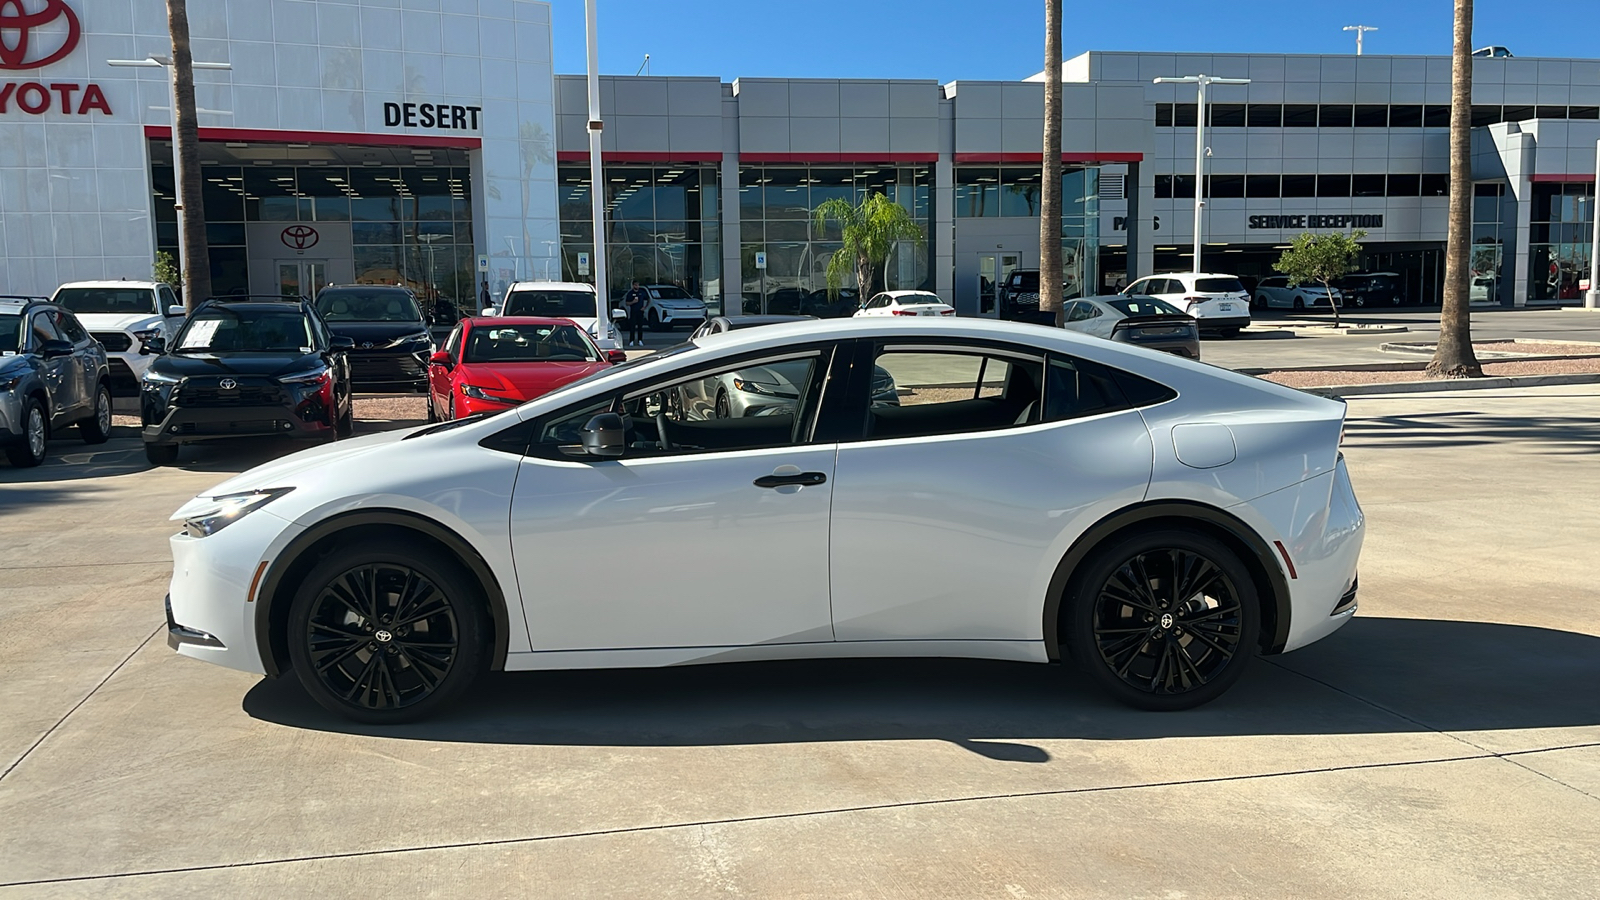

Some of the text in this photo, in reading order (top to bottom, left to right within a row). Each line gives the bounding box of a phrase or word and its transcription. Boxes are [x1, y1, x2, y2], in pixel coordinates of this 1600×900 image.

[384, 102, 482, 130] DESERT
[1248, 214, 1384, 229] SERVICE RECEPTION
